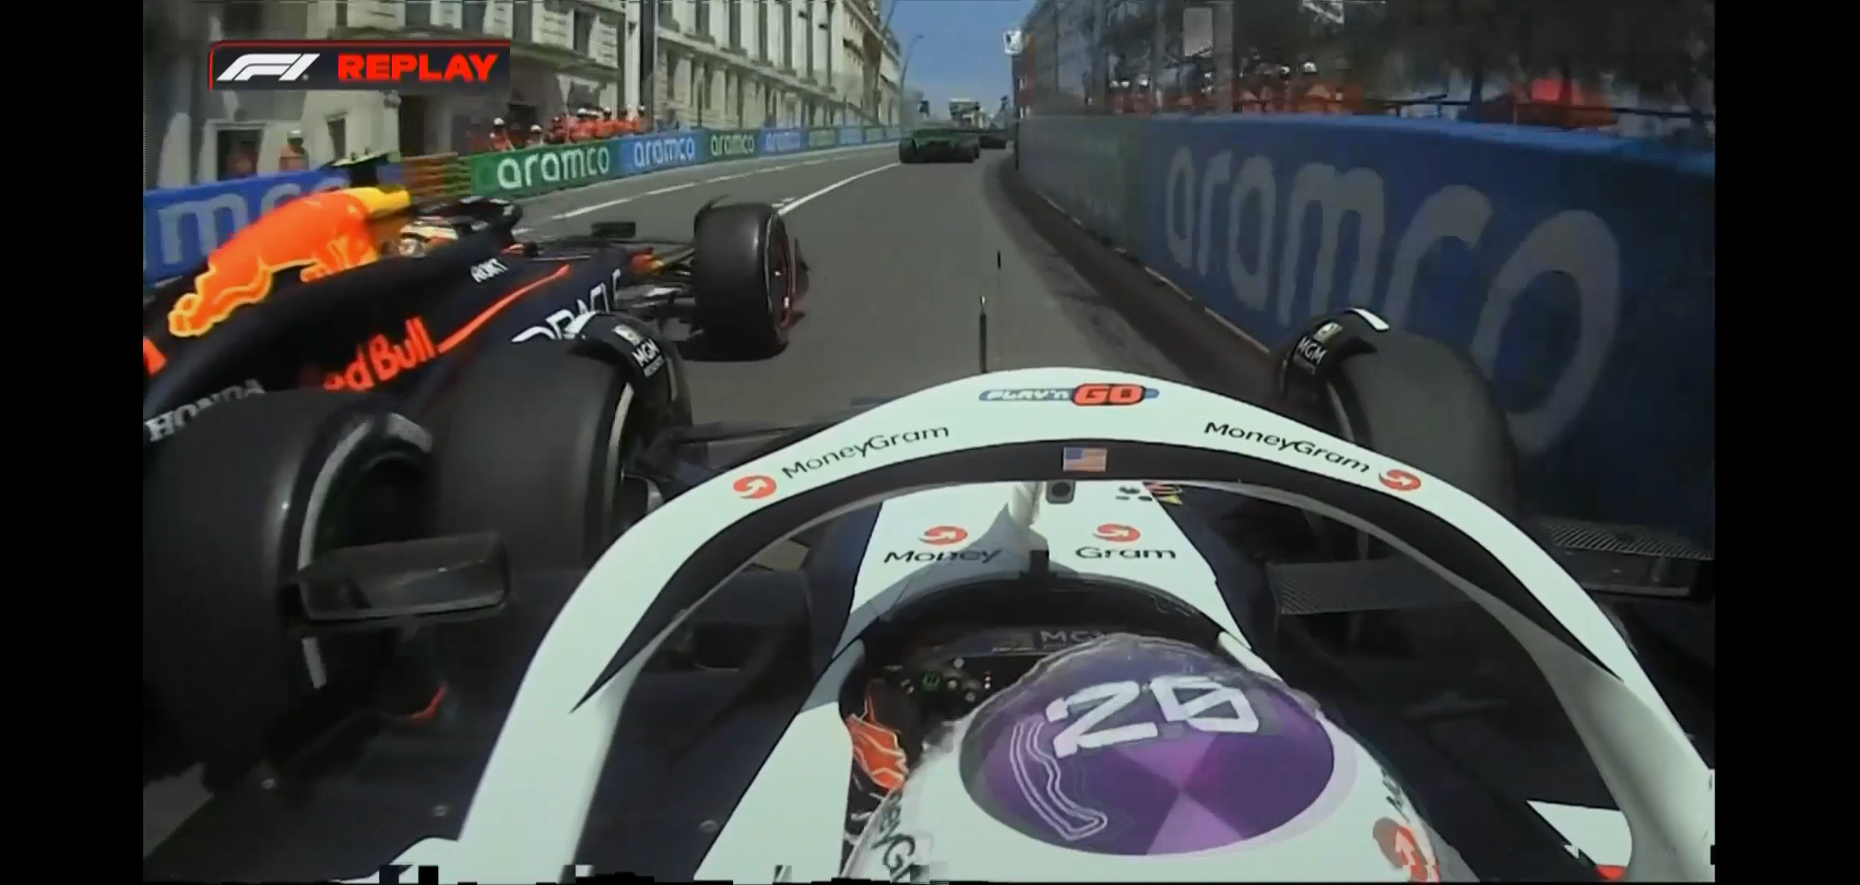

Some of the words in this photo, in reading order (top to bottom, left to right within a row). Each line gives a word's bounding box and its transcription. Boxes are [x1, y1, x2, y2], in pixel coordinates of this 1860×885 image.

[496, 145, 611, 189] aramco
[632, 136, 696, 168] aramco
[1165, 145, 1621, 463] aramco
[368, 315, 437, 382] Bull
[632, 337, 661, 368] MGM
[1298, 336, 1328, 365] MGM
[1073, 383, 1145, 406] GO
[781, 426, 949, 479] MoneyGram
[1203, 421, 1371, 474] MoneyGram
[883, 548, 1000, 564] Money
[1074, 545, 1177, 561] Gram
